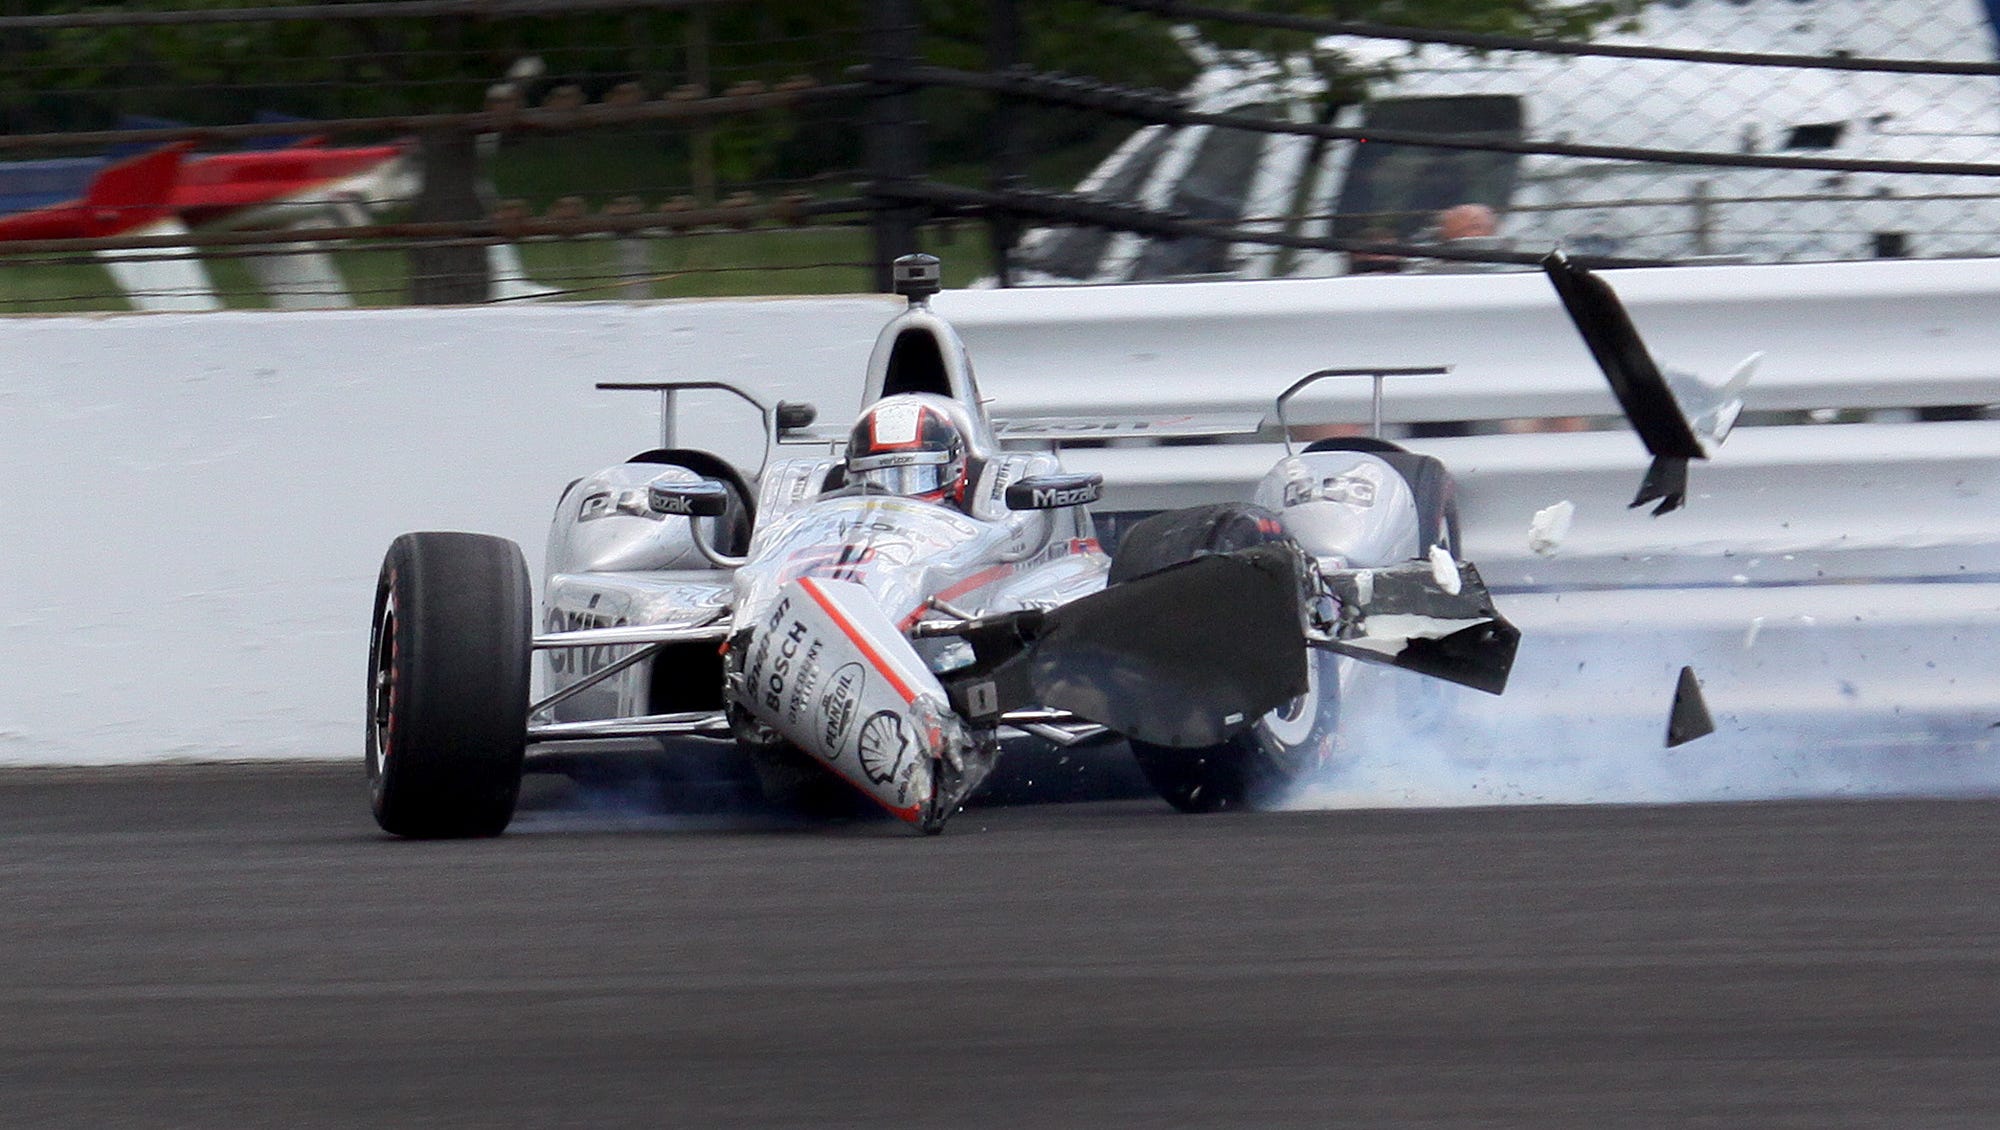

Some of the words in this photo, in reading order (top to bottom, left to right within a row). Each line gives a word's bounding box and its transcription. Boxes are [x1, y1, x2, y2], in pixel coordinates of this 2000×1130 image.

[650, 494, 694, 514] azak
[1032, 485, 1098, 508] Mazak
[766, 620, 808, 713] BOSCH
[825, 674, 853, 749] PENNZOIL
